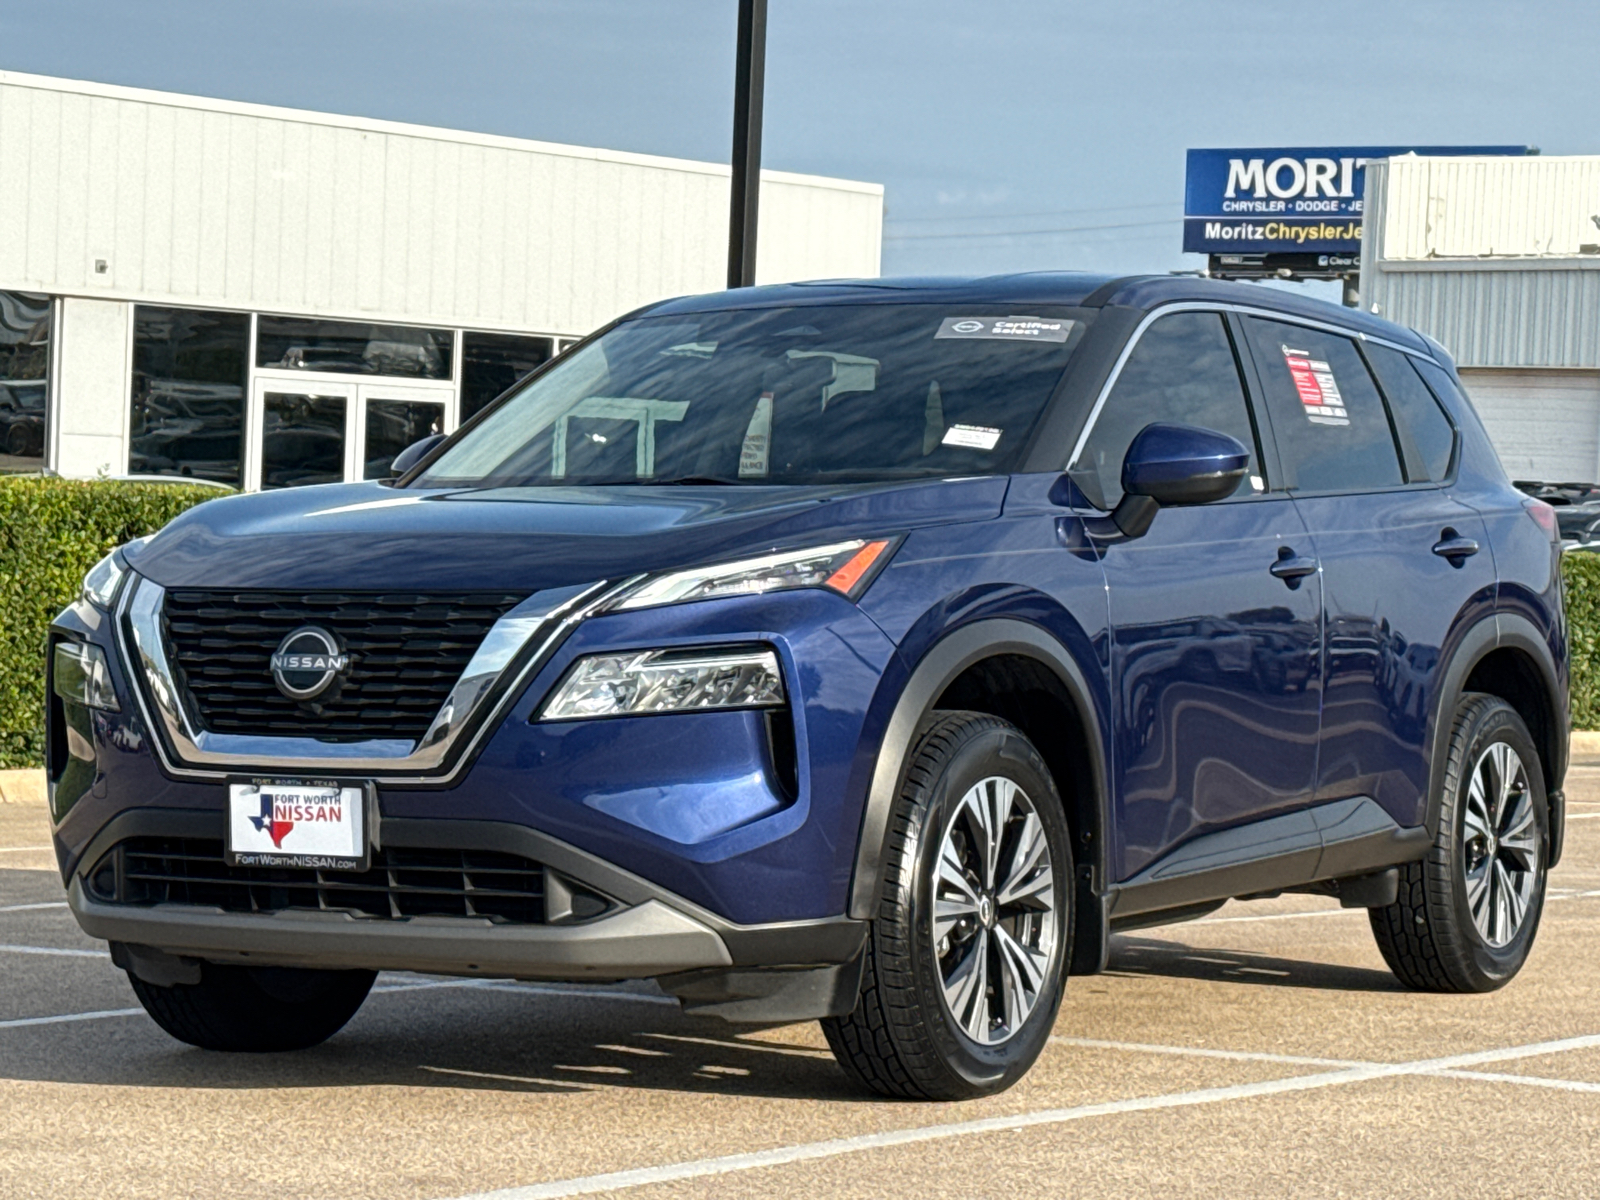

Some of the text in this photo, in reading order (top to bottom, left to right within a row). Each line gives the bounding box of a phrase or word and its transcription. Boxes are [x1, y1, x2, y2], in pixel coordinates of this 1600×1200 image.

[1222, 200, 1286, 212] CHRYSLER
[1295, 200, 1339, 212] DODGE
[992, 327, 1040, 335] Select
[995, 321, 1062, 331] Certified
[272, 657, 342, 668] NISSAN
[275, 794, 341, 805] FORT WORTH
[275, 805, 342, 822] NISSAN
